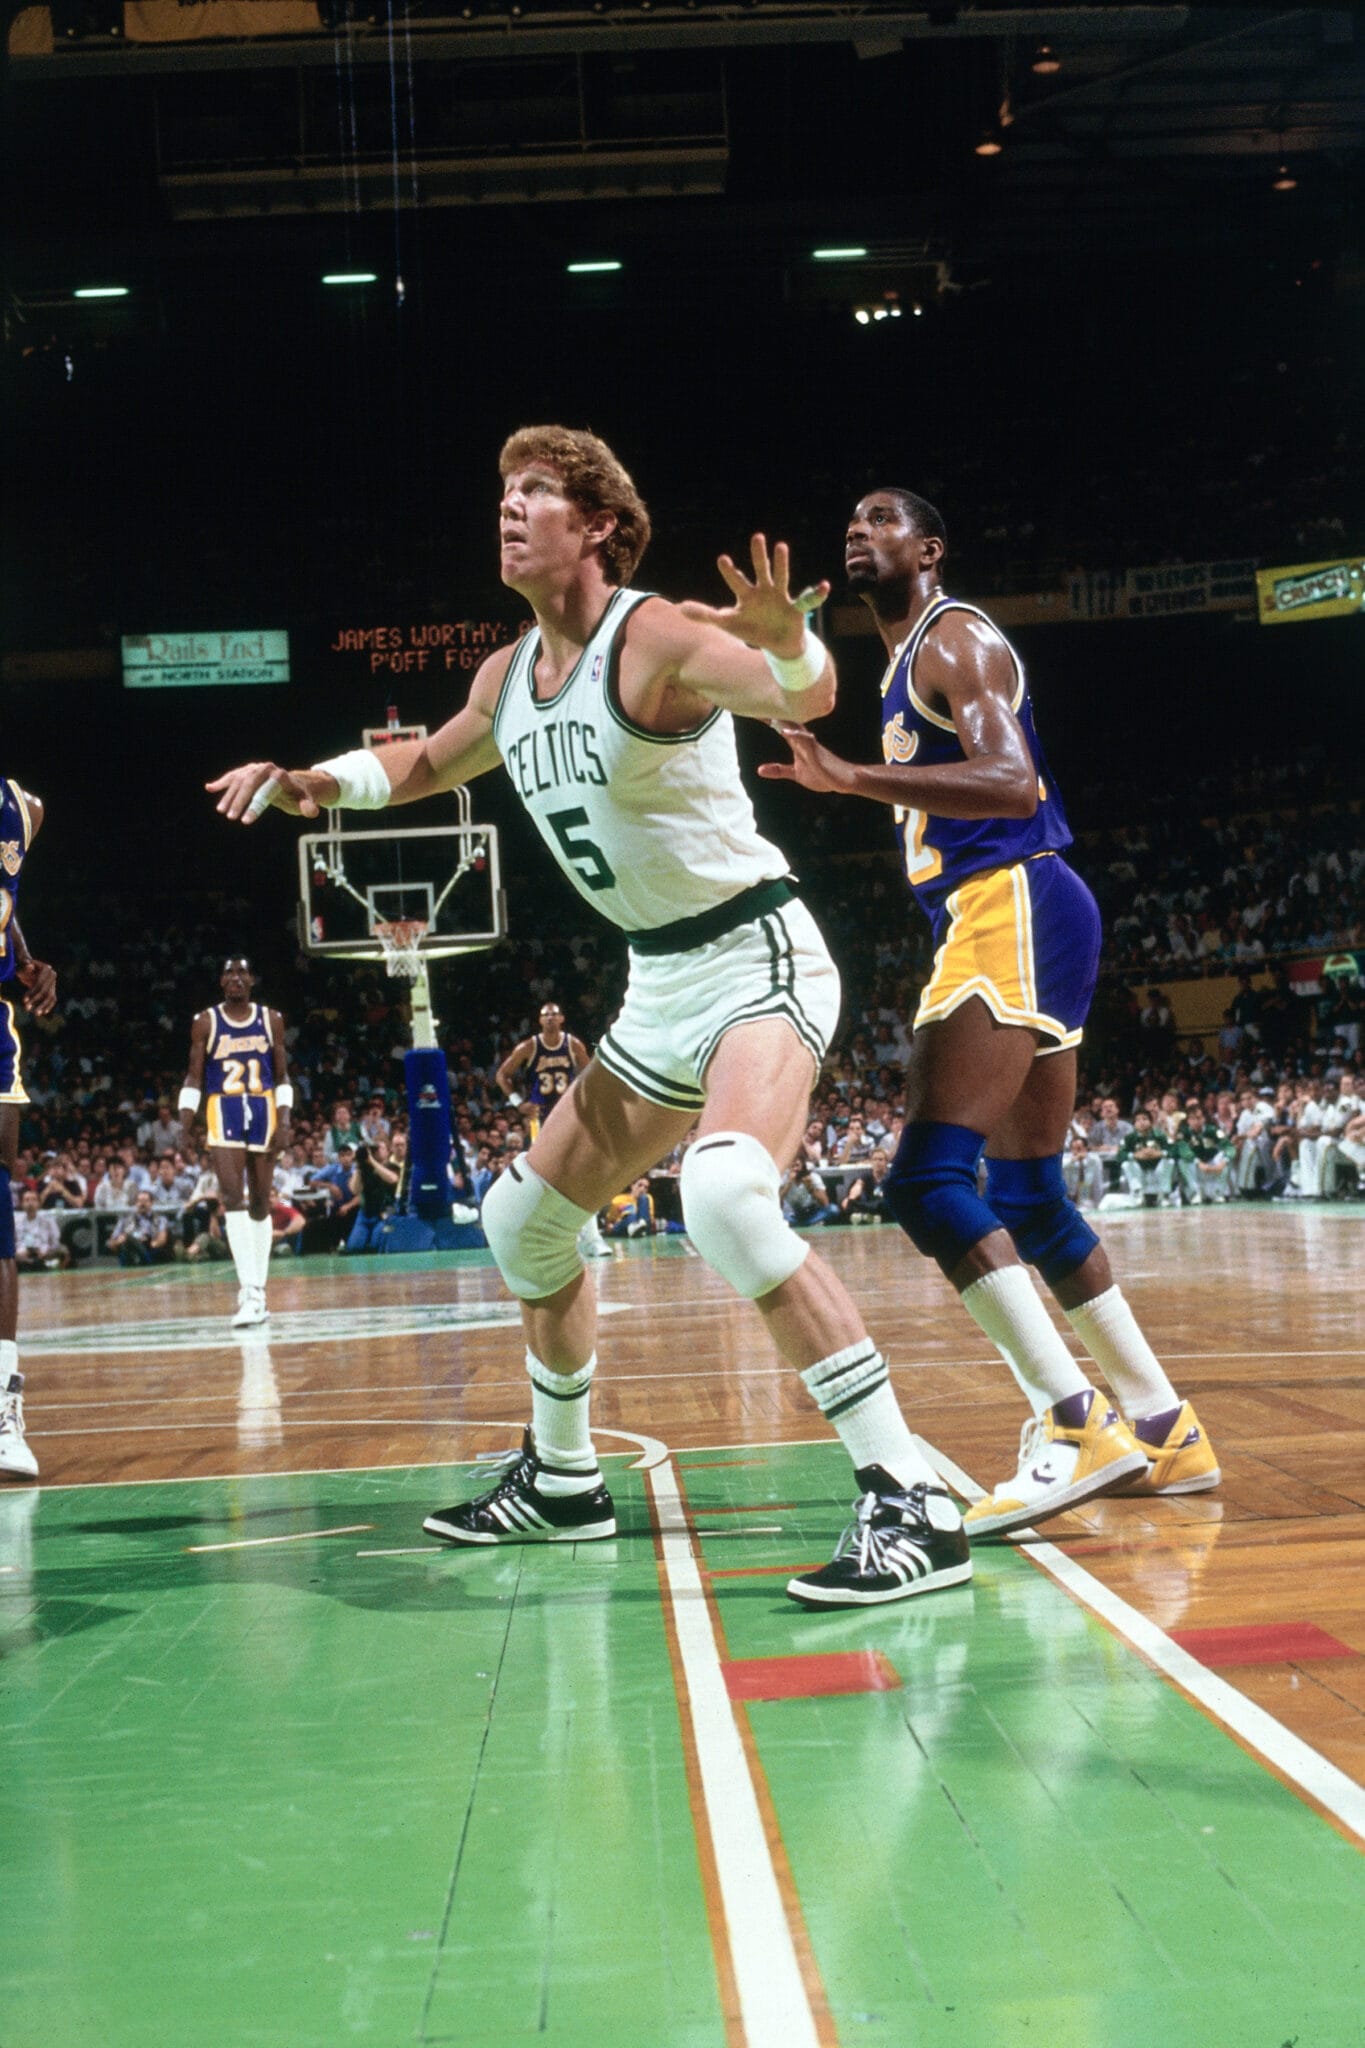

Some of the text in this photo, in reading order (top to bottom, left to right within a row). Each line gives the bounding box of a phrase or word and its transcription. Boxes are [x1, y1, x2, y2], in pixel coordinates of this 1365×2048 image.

[331, 626, 403, 651] JAMES
[410, 622, 508, 647] WORTHY:
[161, 670, 211, 681] NORTH
[217, 668, 274, 680] STATION
[508, 720, 608, 799] CELTICS
[546, 806, 617, 892] 5
[222, 1058, 264, 1096] 21
[538, 1071, 569, 1096] 33
